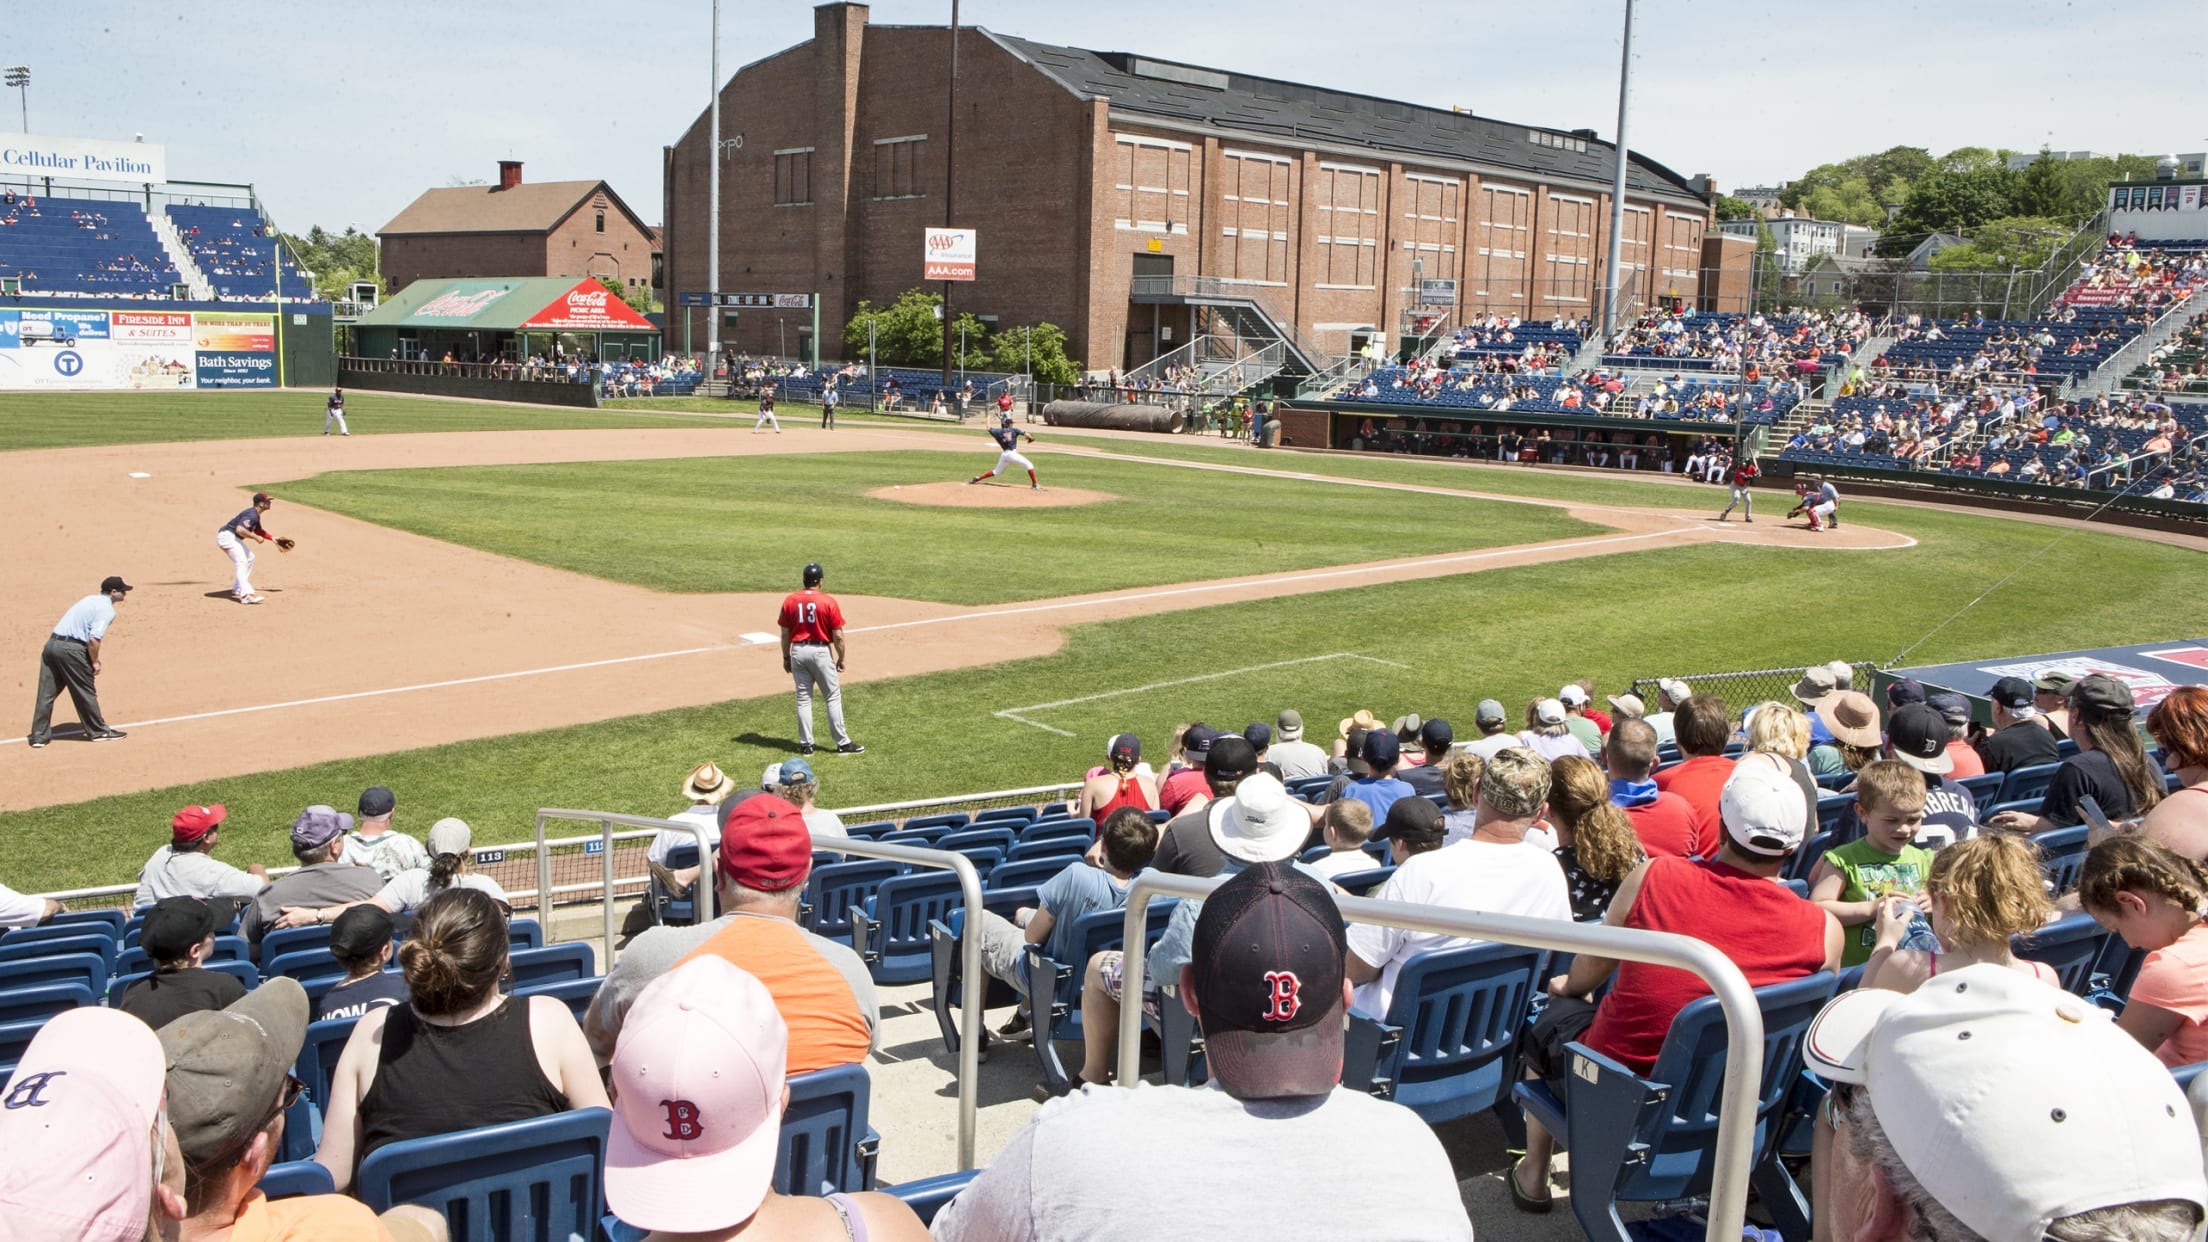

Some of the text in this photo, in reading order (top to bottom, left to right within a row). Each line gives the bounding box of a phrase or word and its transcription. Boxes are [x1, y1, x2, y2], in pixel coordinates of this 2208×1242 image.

[3, 148, 151, 174] Cellular Pavilion
[928, 266, 973, 276] AAA.com
[567, 290, 609, 306] Coca-Cola
[22, 311, 106, 323] Need Propane?
[167, 315, 185, 325] INN
[128, 329, 176, 337] & SUITES
[199, 356, 273, 370] Bath Savings
[797, 602, 817, 624] 13
[1920, 786, 1976, 824] ABRERA
[589, 842, 603, 852] 11
[480, 851, 502, 862] 113
[1262, 970, 1302, 1022] B
[1581, 1058, 1590, 1079] K
[658, 1099, 704, 1141] B
